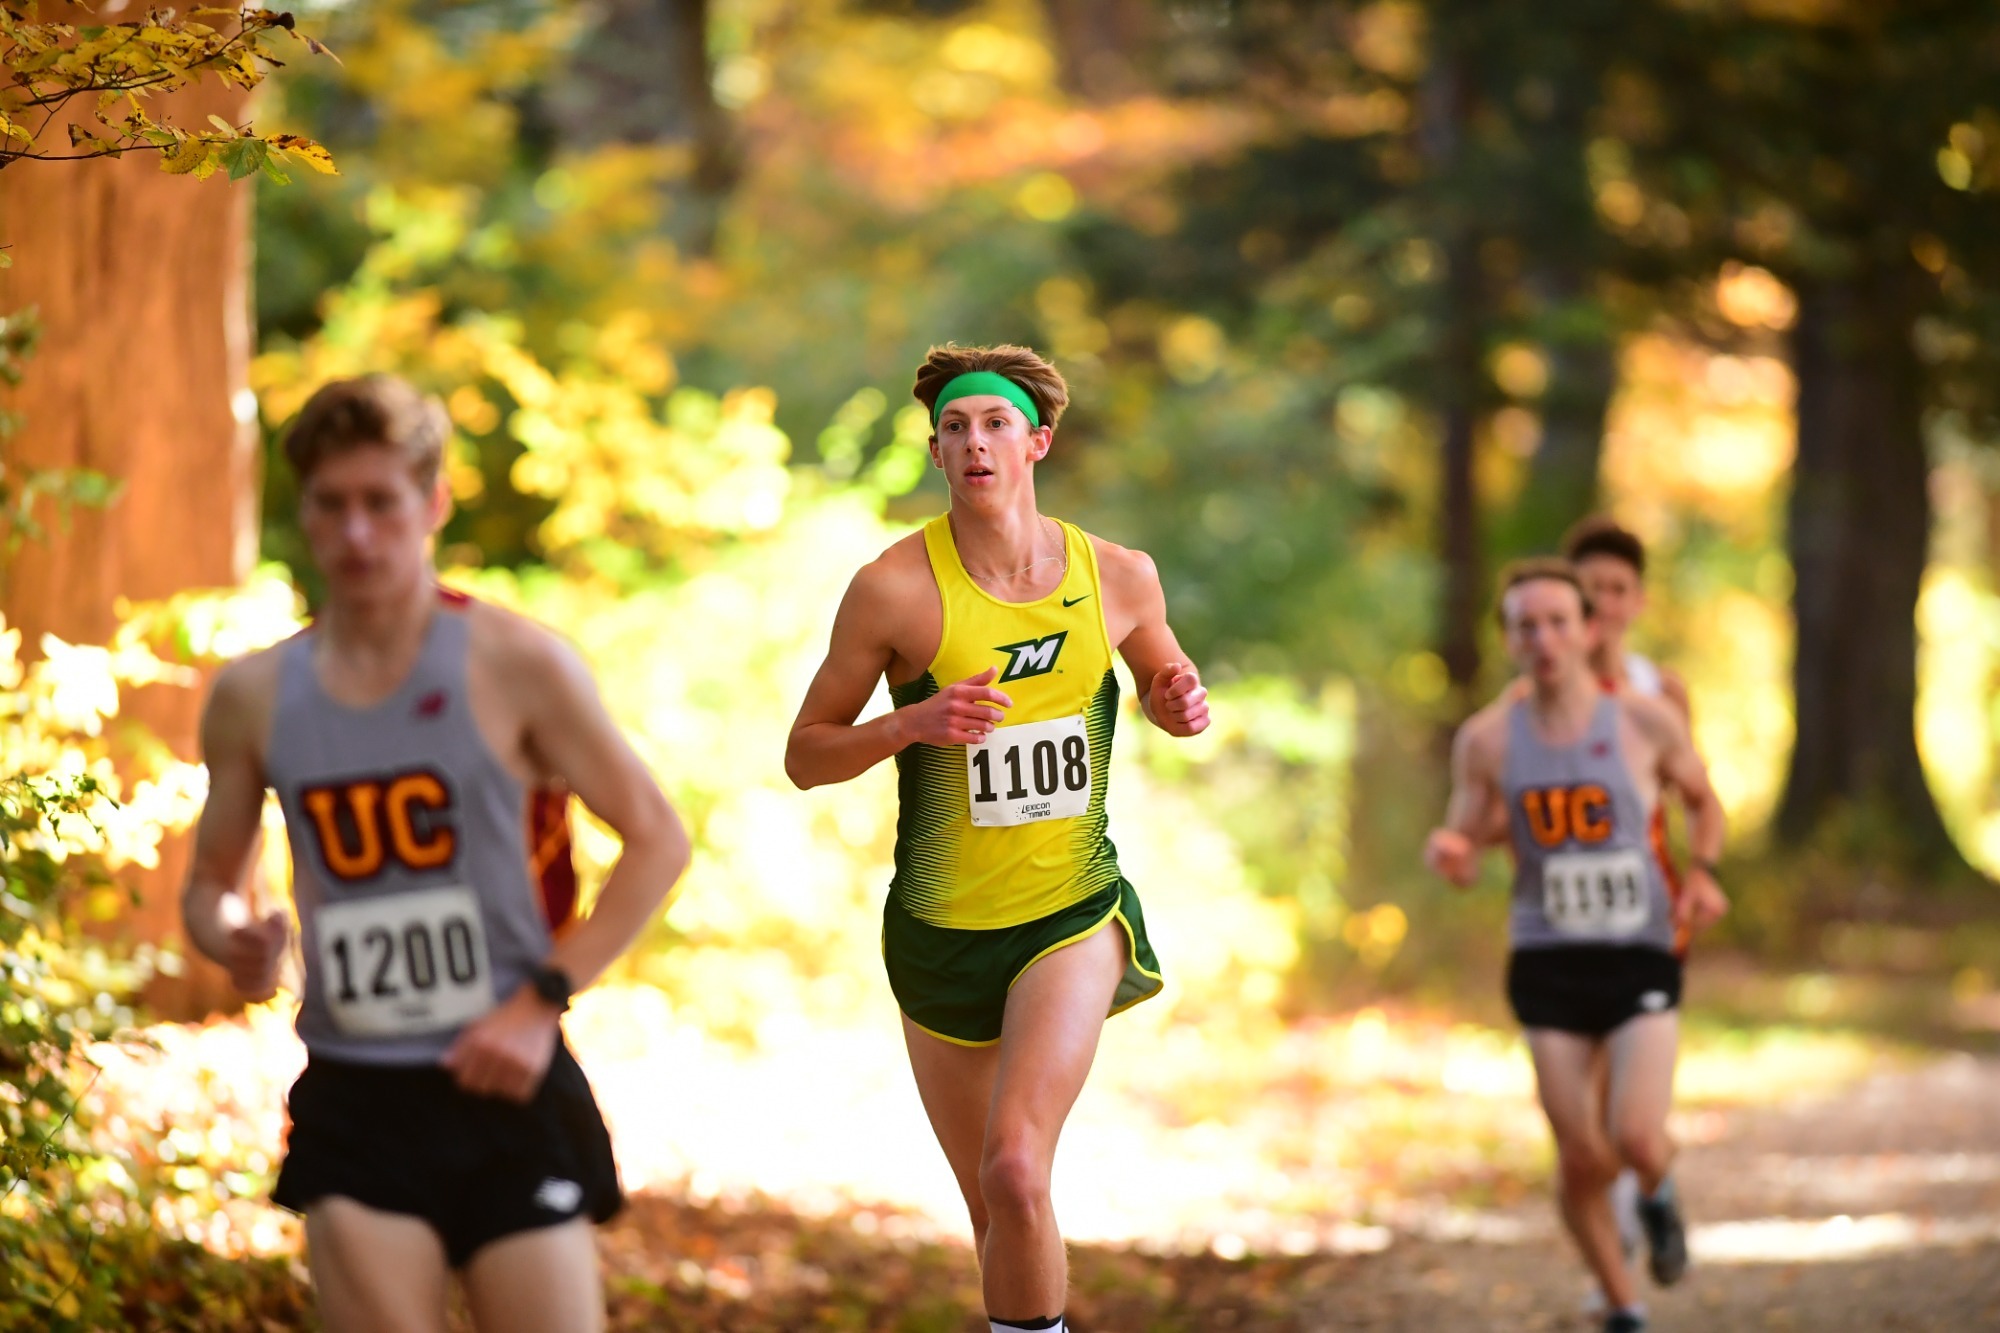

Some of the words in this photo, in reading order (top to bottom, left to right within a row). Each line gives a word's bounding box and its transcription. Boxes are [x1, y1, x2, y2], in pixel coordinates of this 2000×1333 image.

[972, 735, 1087, 802] 1108
[302, 770, 458, 880] UC
[1021, 802, 1051, 813] LEXICON
[1027, 810, 1051, 818] TIMING
[1521, 784, 1613, 848] UC
[330, 916, 476, 1005] 1200
